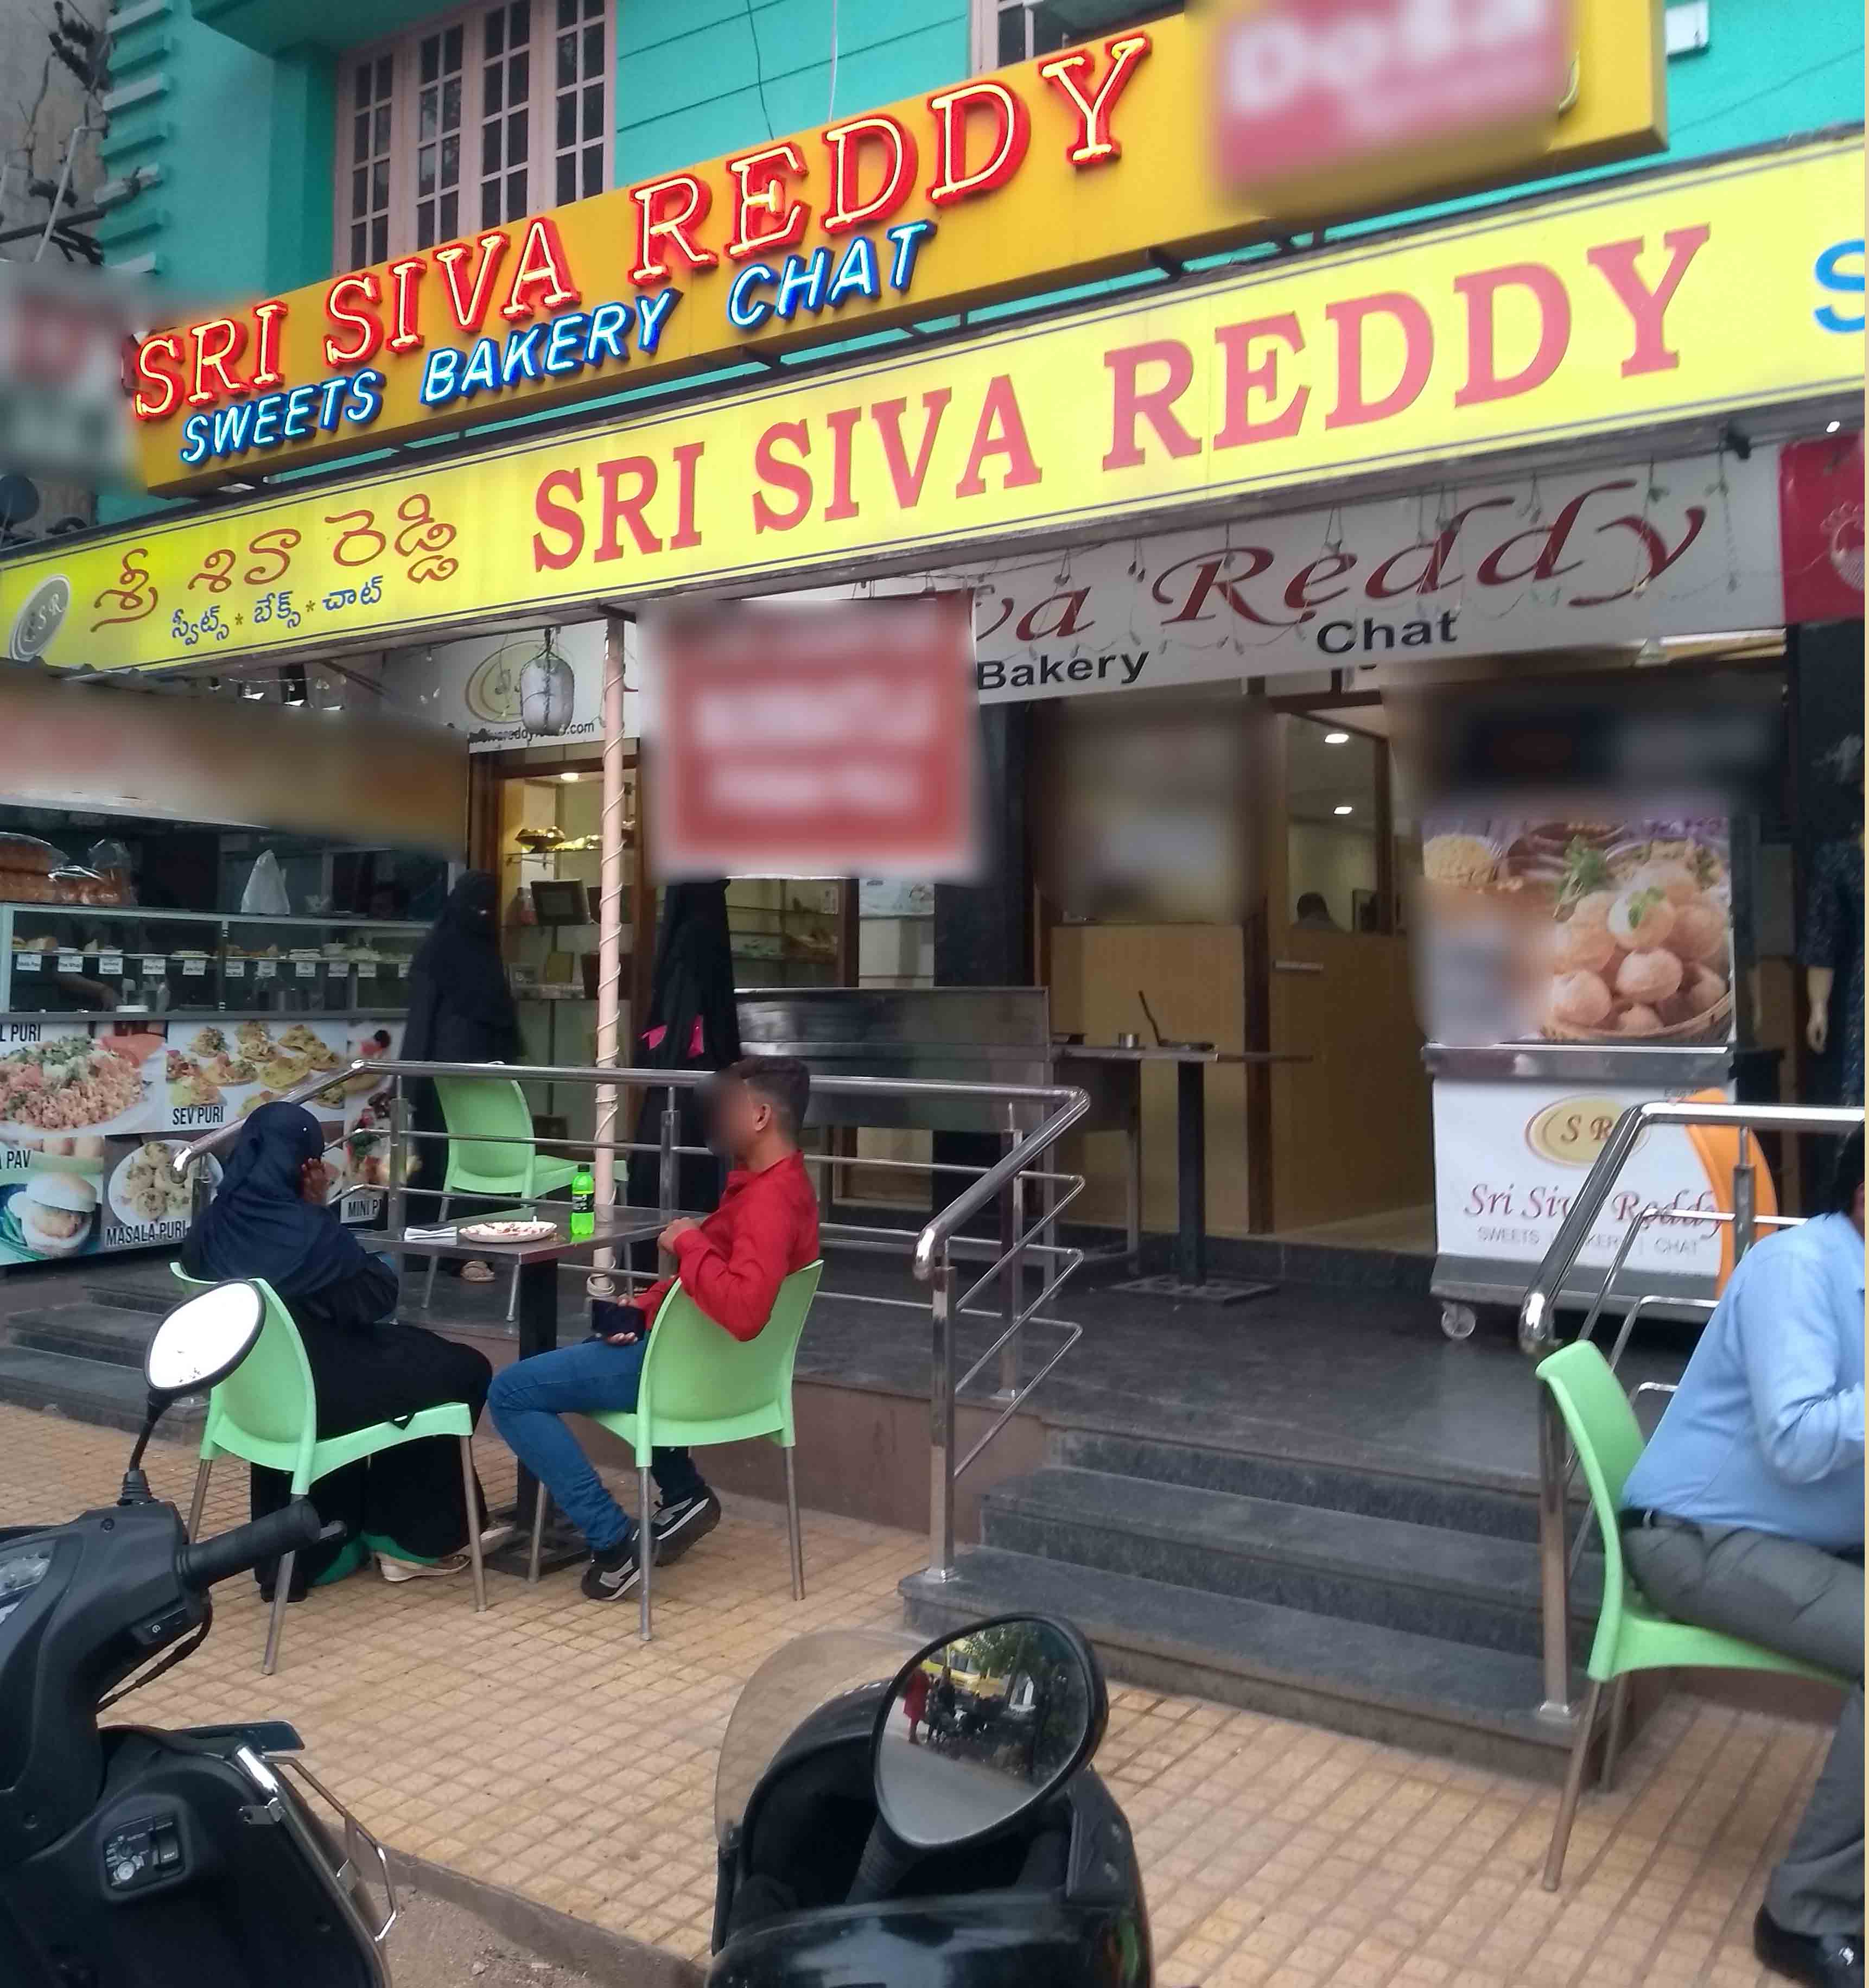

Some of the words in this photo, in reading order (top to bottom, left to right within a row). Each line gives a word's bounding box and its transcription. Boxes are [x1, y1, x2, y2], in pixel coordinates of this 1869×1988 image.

[134, 300, 288, 421] SRI
[325, 217, 581, 366] SIVA
[627, 31, 1152, 287] REDDY
[181, 367, 386, 465] SWEETS
[421, 288, 683, 407] BAKERY
[728, 219, 937, 328] CHAT
[533, 441, 704, 573] SRI
[752, 374, 1042, 535] SIVA
[1103, 222, 1711, 471] REDDY
[90, 548, 158, 632] శ్రీ
[187, 528, 302, 593] శివా
[325, 493, 459, 583] రెడ్డి
[1152, 479, 1706, 627] Reddy
[977, 651, 1149, 690] Bakery
[1317, 609, 1459, 654] Chat
[11, 1025, 41, 1041] PURI
[173, 1107, 194, 1125] SEV
[197, 1106, 224, 1124] PURI
[7, 1149, 31, 1169] PAV
[348, 1200, 370, 1217] MINI
[1464, 1184, 1515, 1216] Sri
[107, 1224, 155, 1246] MASALA
[159, 1221, 186, 1240] PURI
[1477, 1227, 1540, 1246] SWEETS
